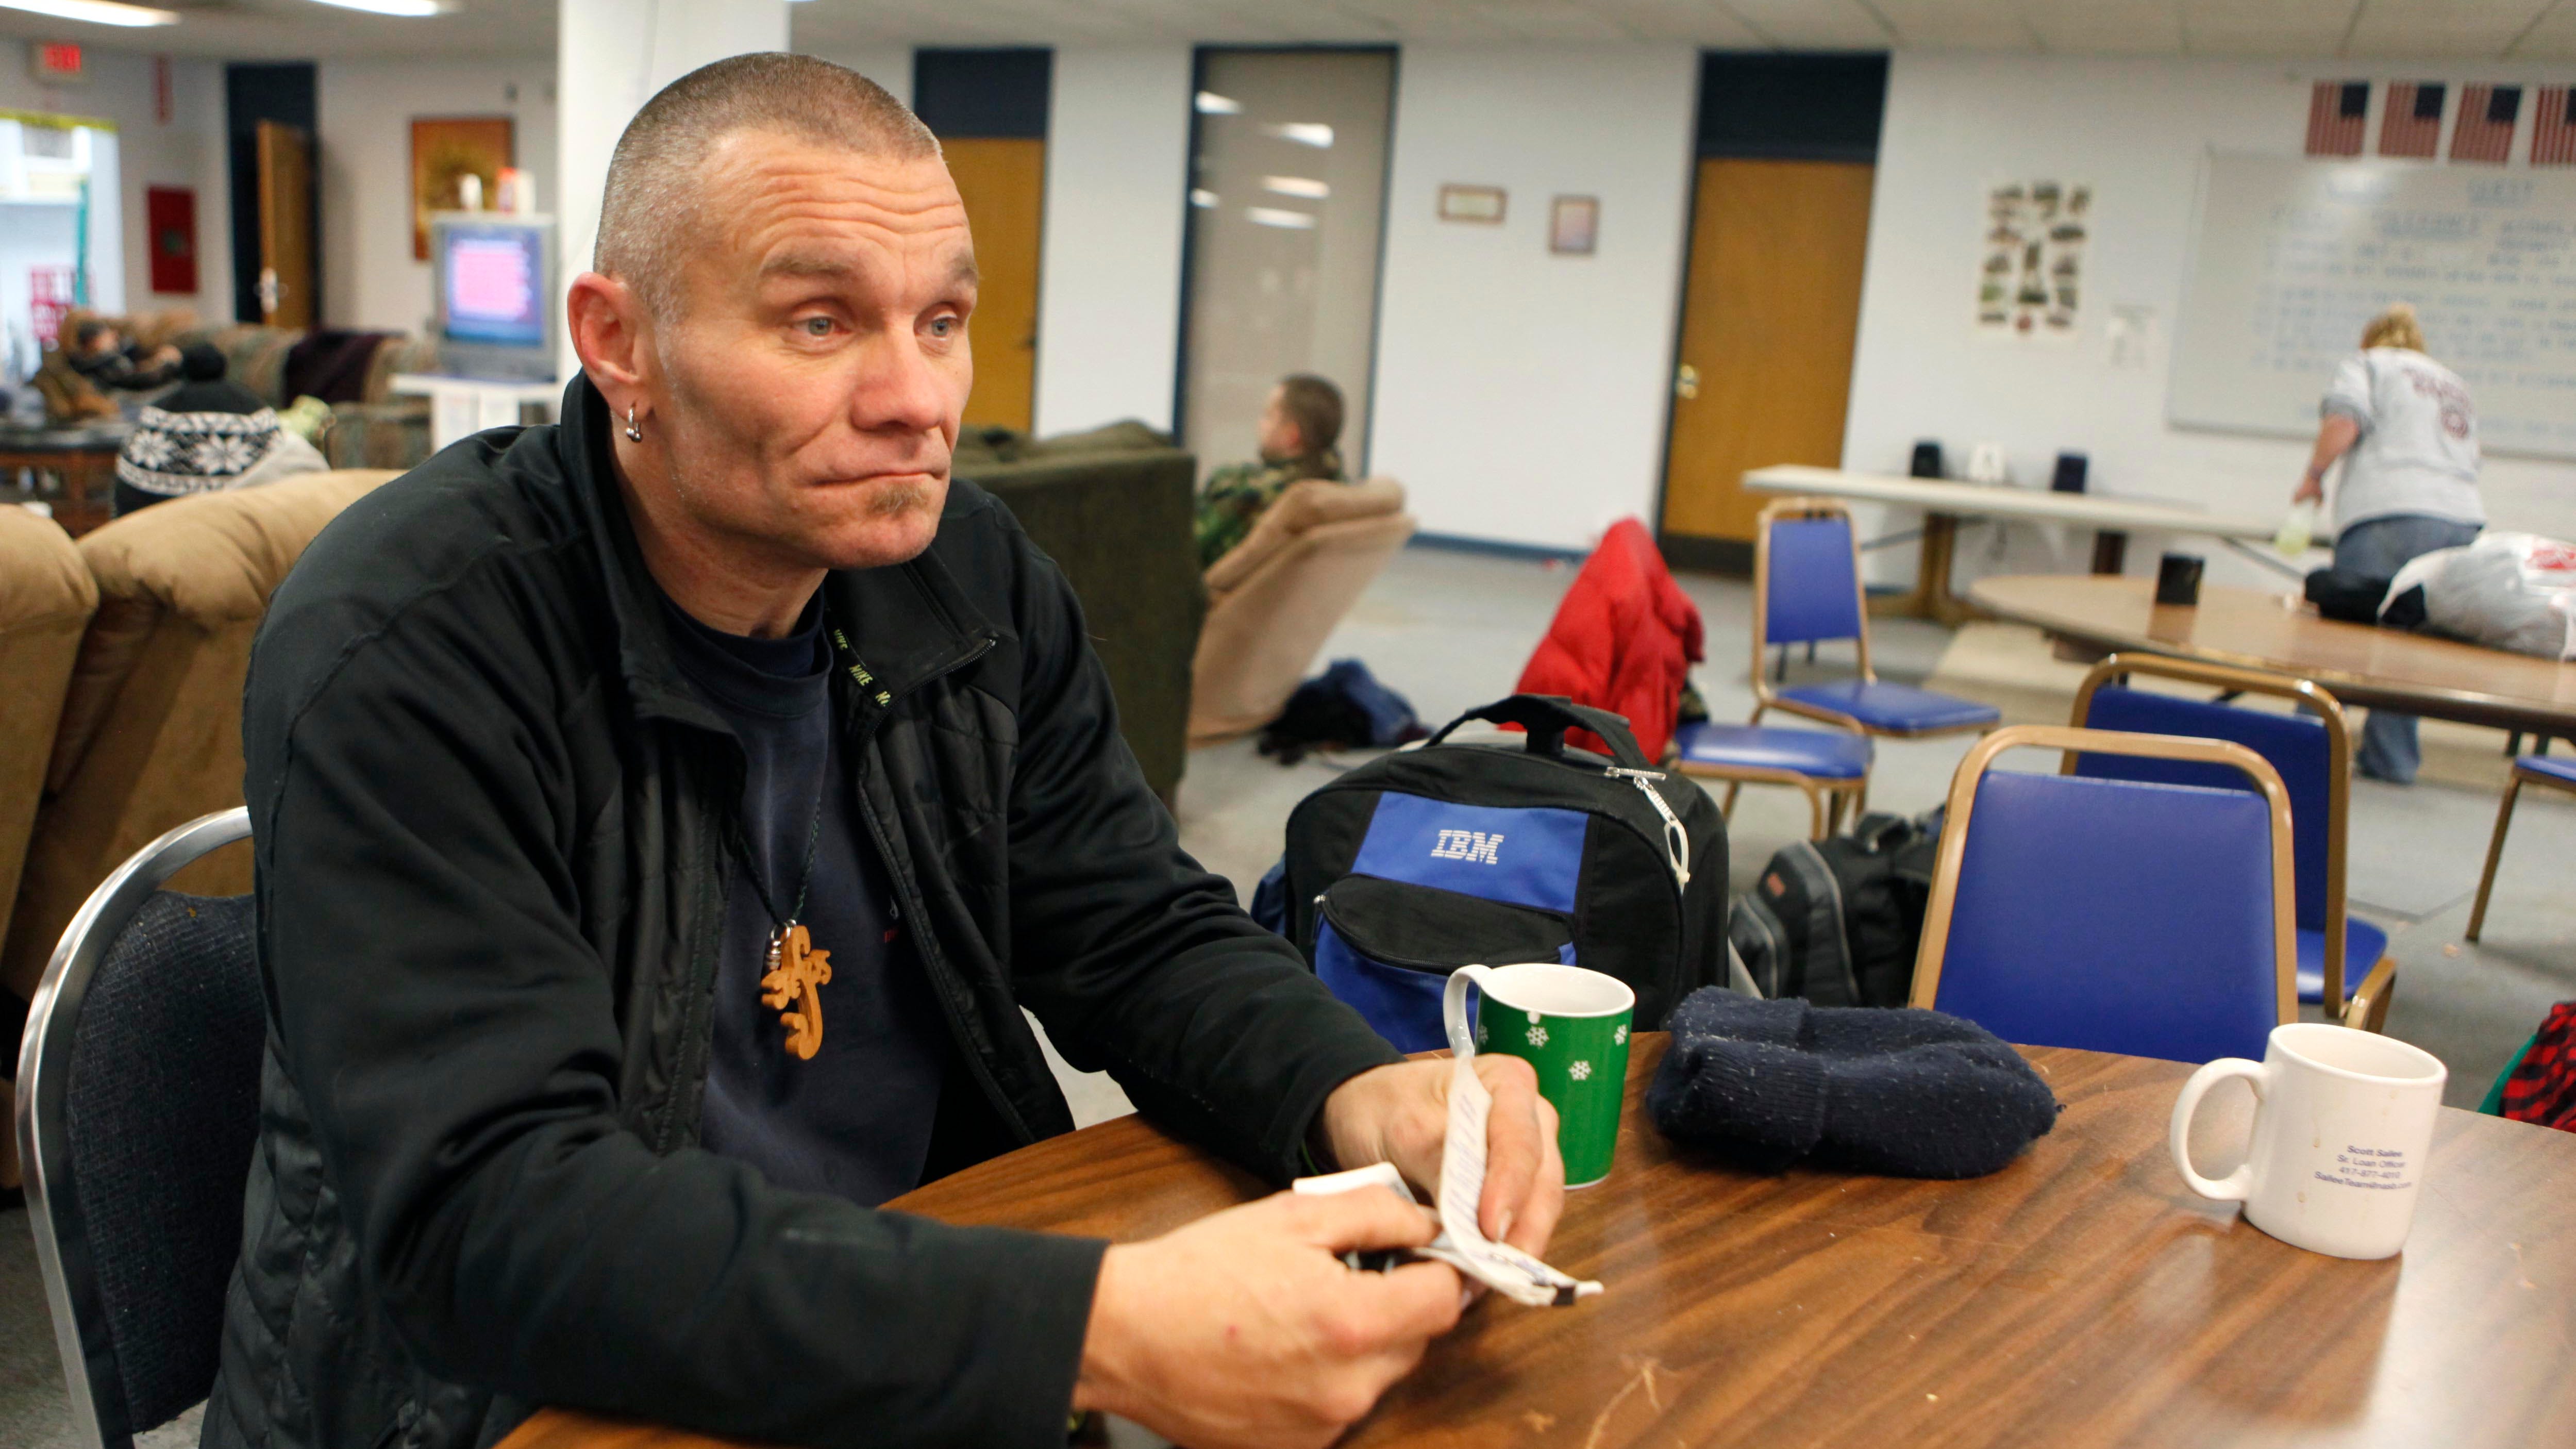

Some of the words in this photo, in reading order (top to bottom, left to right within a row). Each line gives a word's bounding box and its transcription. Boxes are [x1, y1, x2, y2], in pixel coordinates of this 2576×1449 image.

[849, 664, 873, 686] NIKE
[1430, 829, 1505, 865] IBM
[2347, 1145, 2374, 1156] Scott
[2353, 1158, 2376, 1167] Loan
